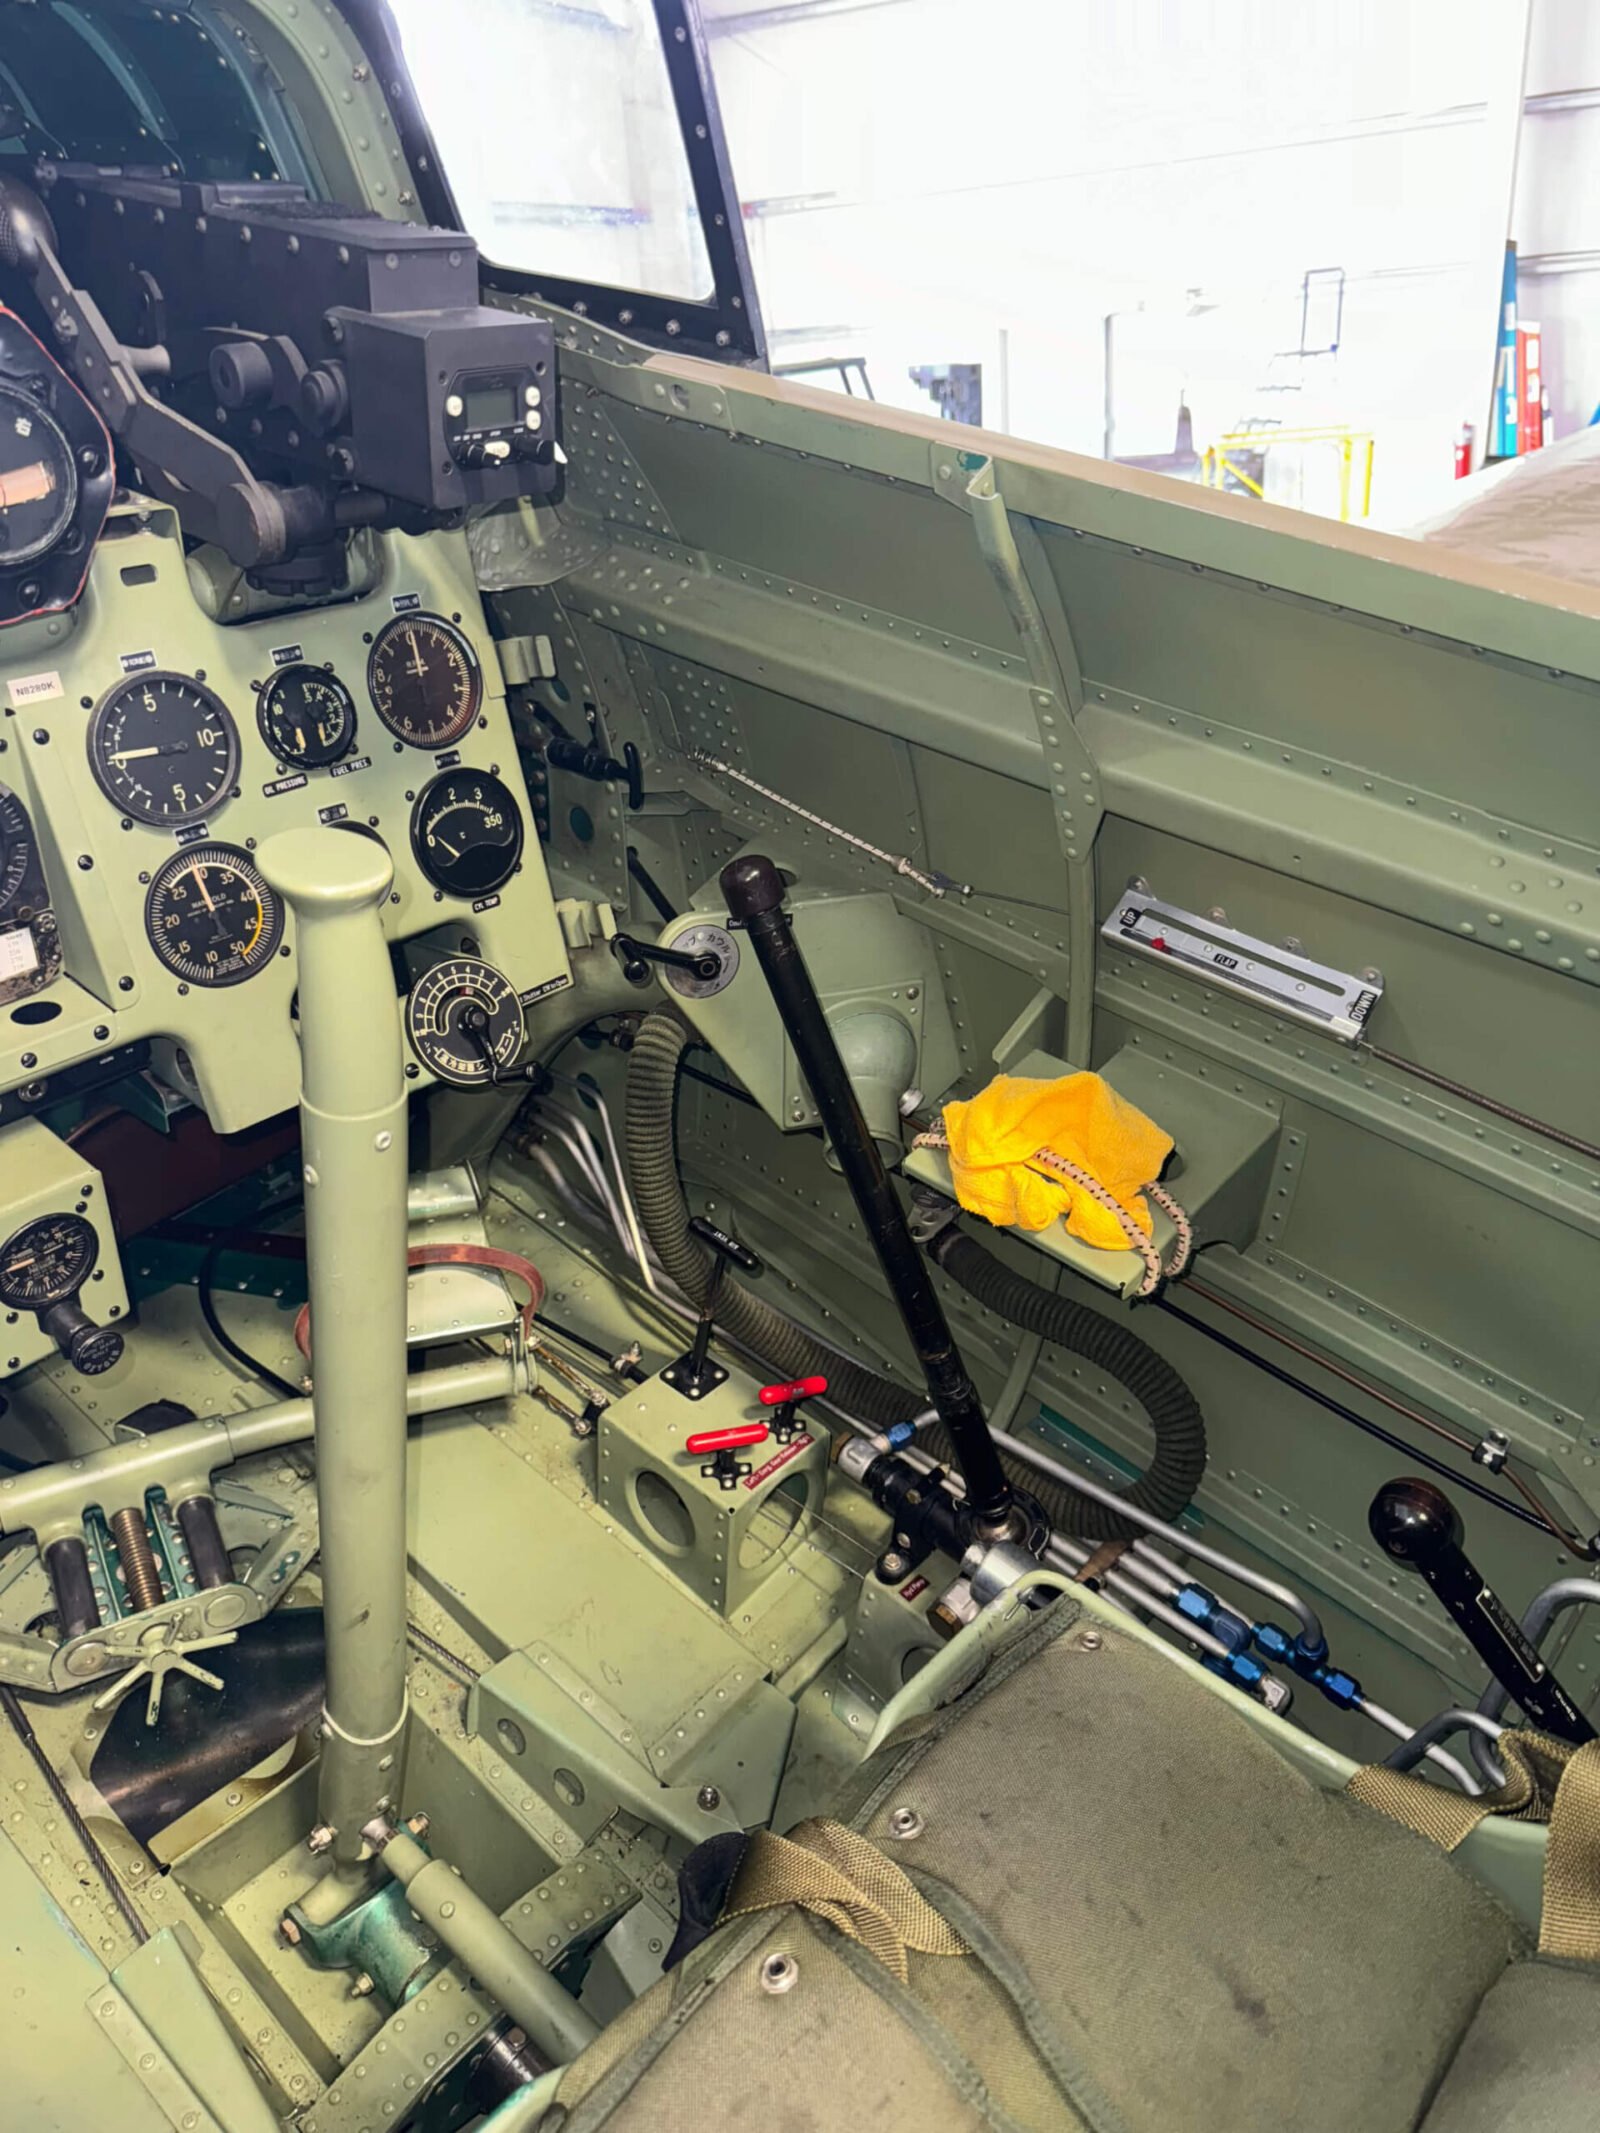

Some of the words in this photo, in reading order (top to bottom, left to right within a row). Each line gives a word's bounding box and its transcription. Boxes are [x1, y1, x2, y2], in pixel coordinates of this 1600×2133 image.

[447, 653, 456, 667] 2
[377, 669, 385, 682] 8
[143, 693, 157, 712] 5
[447, 704, 455, 717] 4
[404, 716, 412, 730] 6
[197, 728, 215, 748] 10
[332, 765, 349, 777] FUEL
[173, 784, 186, 801] 5
[264, 785, 275, 796] OIL
[275, 775, 306, 792] PRESSURE
[448, 788, 456, 800] 2
[474, 787, 482, 799] 3
[483, 813, 503, 829] 350
[427, 835, 435, 847] 0
[220, 871, 235, 885] 35
[171, 886, 187, 900] 25
[240, 890, 255, 902] 40
[485, 897, 498, 907] TEMP
[164, 914, 180, 928] 20
[244, 917, 258, 930] 45
[1124, 911, 1136, 925] UP
[178, 940, 191, 954] 15
[230, 941, 245, 955] 50
[205, 950, 218, 963] 10
[1215, 954, 1236, 968] FLAP
[465, 965, 471, 974] 4
[1350, 991, 1376, 1022] DOWN
